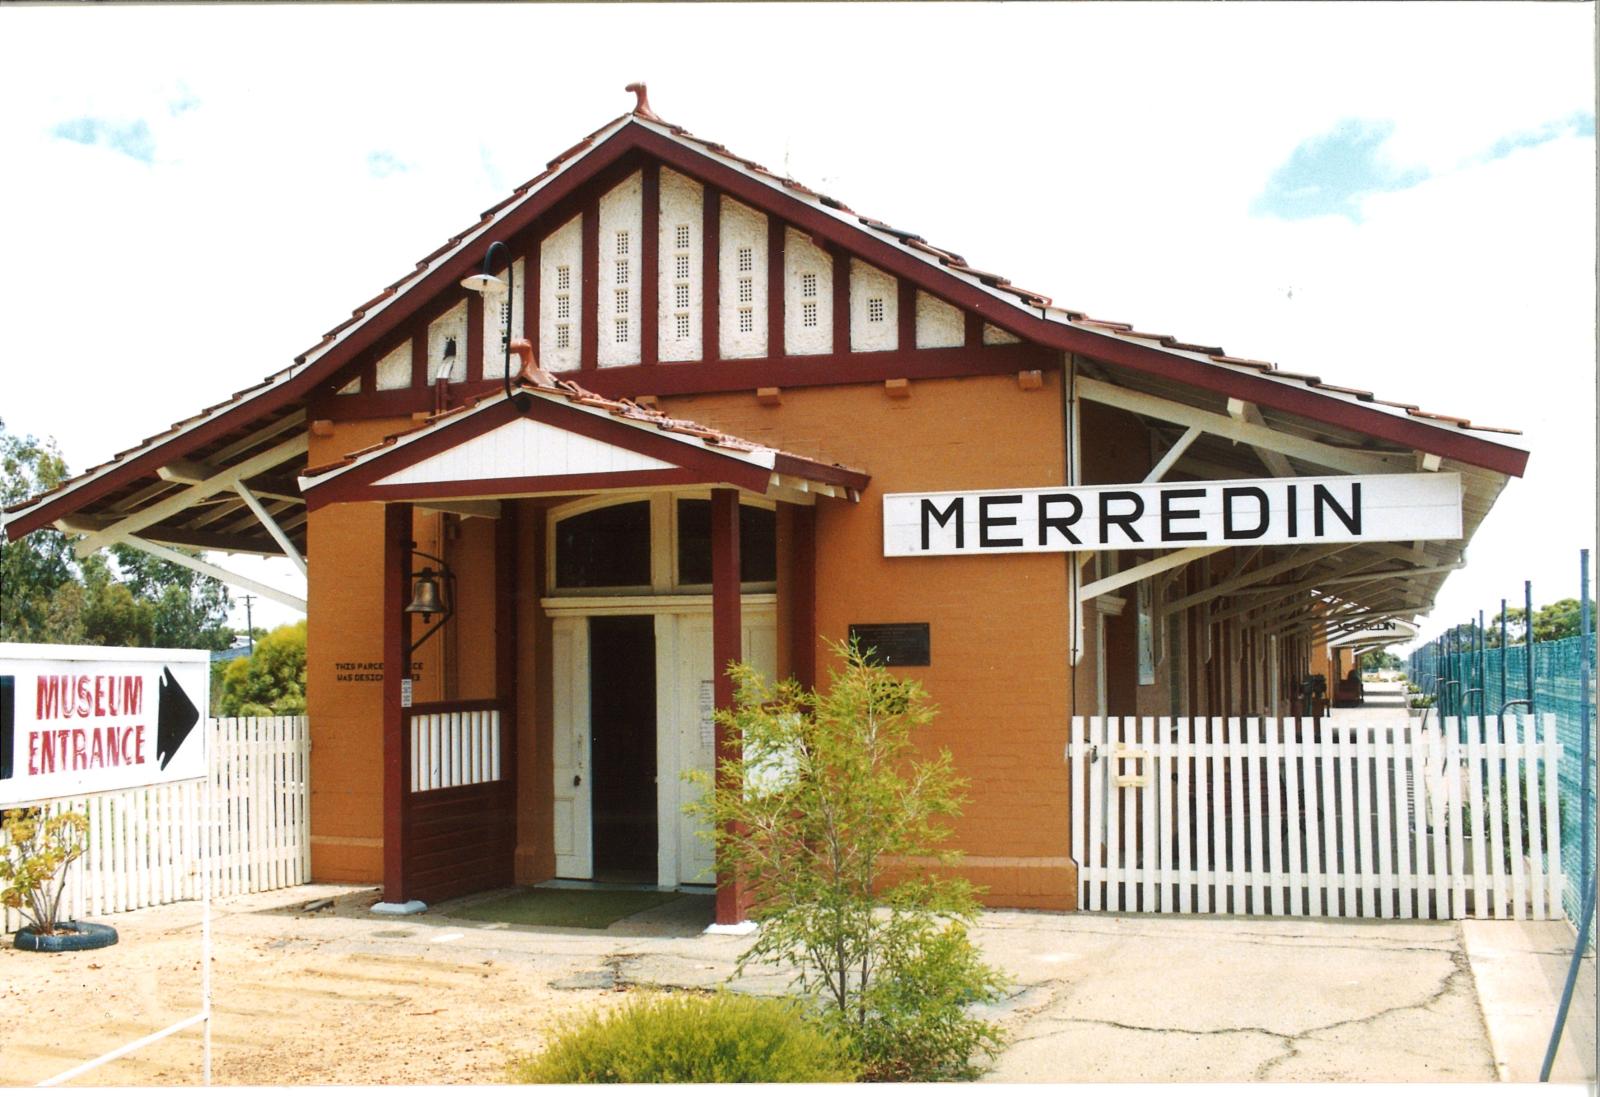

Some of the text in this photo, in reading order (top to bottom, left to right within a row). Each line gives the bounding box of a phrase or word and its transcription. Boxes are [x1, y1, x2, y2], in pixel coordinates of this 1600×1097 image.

[919, 482, 1362, 551] MERREDIN
[357, 662, 384, 670] PARCE
[36, 675, 144, 720] MUSEUM
[28, 725, 146, 776] ENTRANCE
